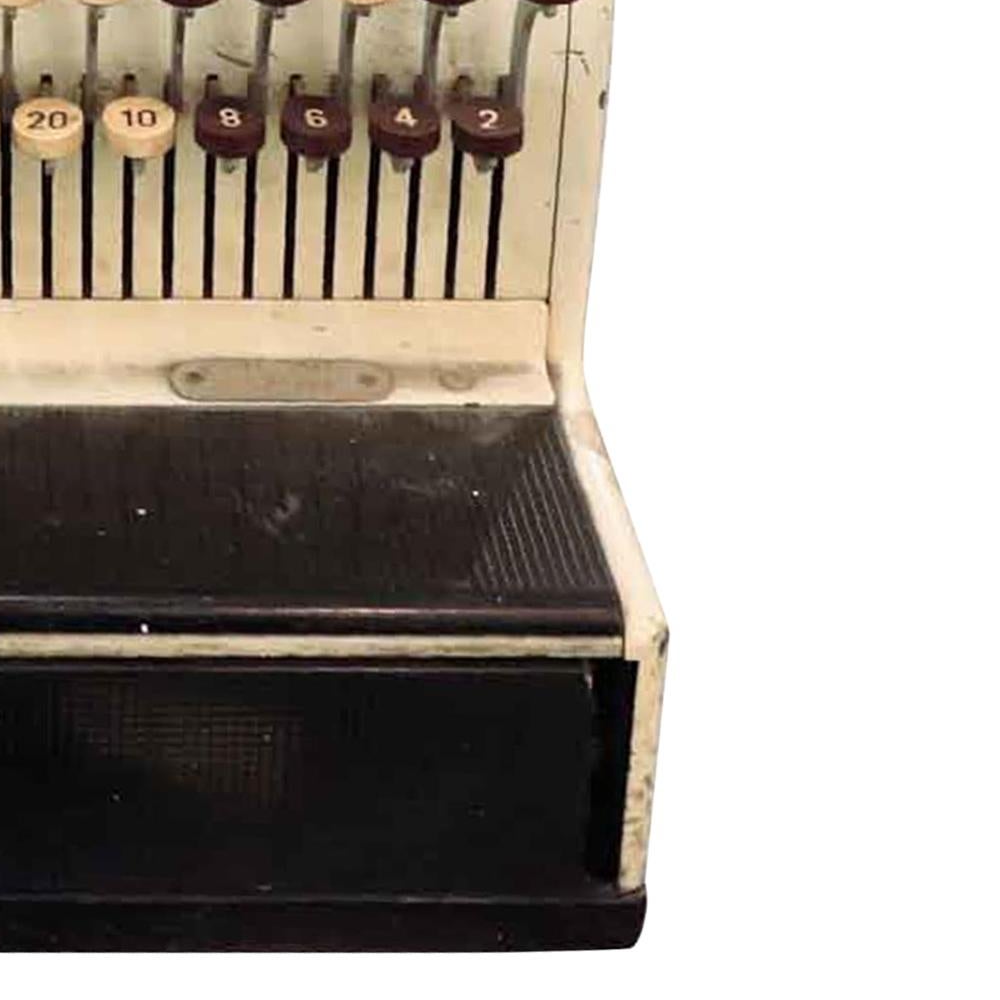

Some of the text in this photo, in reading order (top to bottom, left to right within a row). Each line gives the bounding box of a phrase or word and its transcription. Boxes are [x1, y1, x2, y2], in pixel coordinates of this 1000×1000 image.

[27, 111, 68, 129] 20
[121, 109, 156, 127] 10
[219, 109, 241, 127] 8
[304, 109, 327, 127] 6
[394, 108, 417, 127] 4
[477, 110, 499, 129] 2
